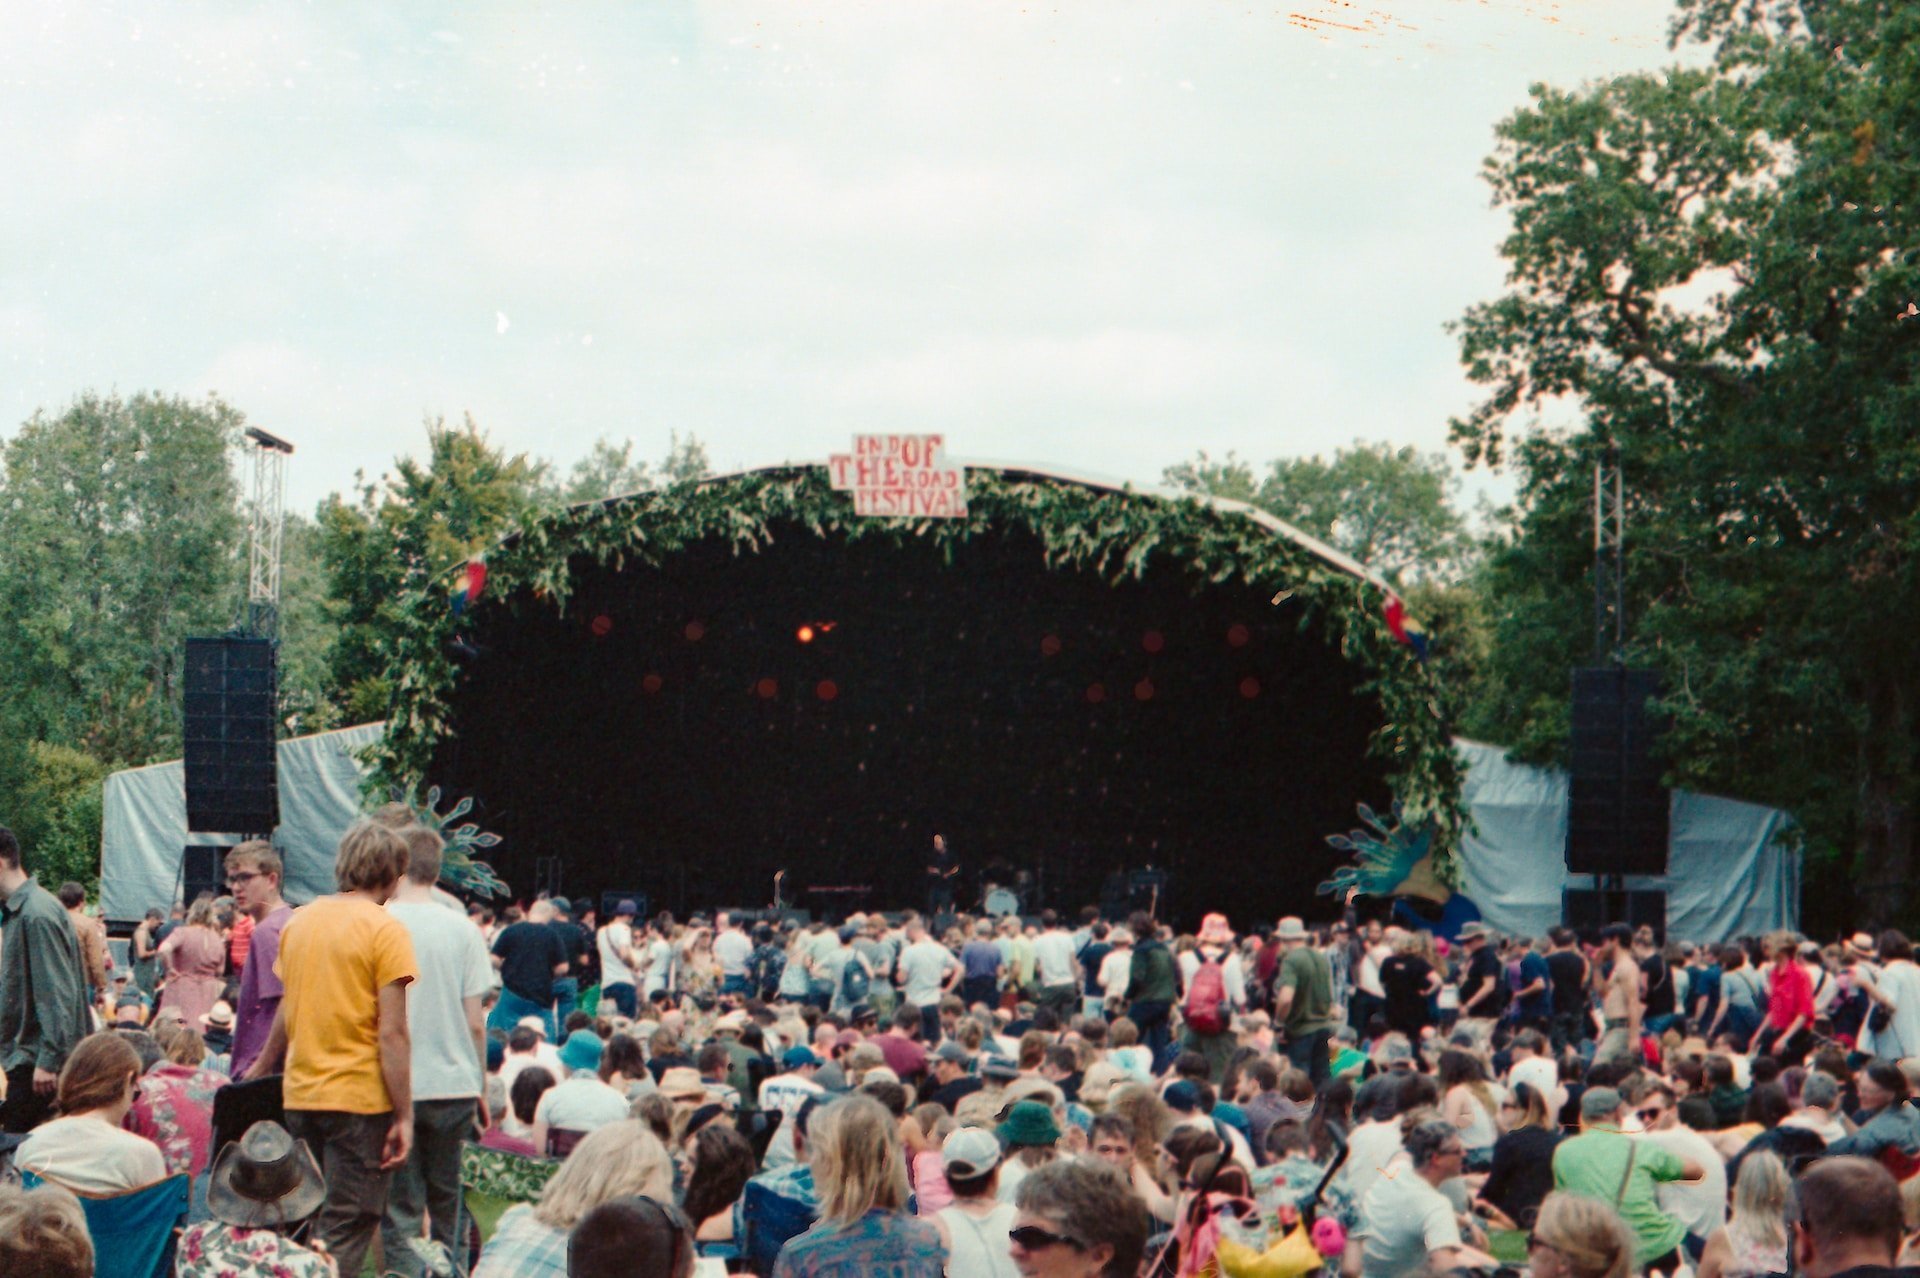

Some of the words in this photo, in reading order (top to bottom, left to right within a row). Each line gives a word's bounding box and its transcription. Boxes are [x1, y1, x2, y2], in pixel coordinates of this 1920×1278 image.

[856, 435, 899, 454] END
[901, 434, 942, 468] OF
[830, 455, 899, 486] THE
[902, 469, 957, 488] ROAD
[857, 488, 967, 516] FESTIVAL
